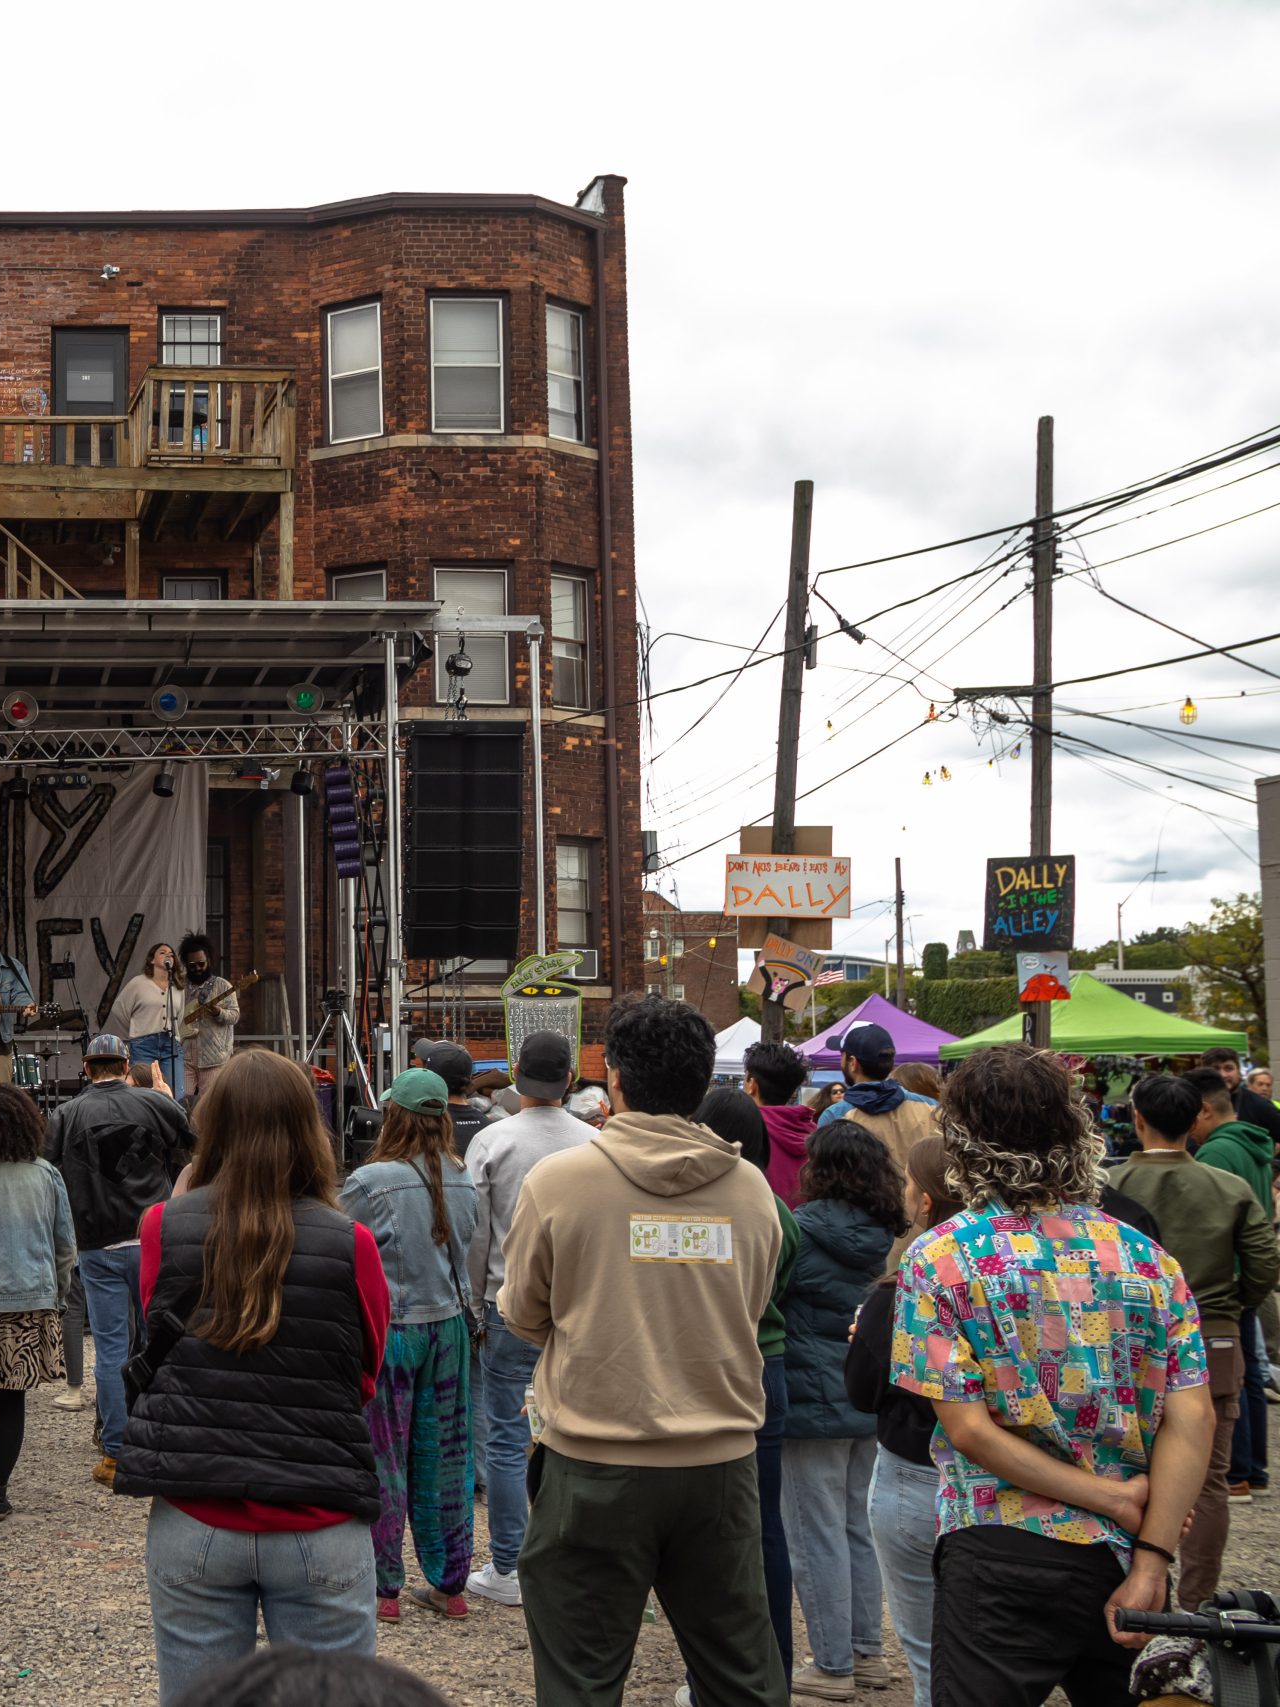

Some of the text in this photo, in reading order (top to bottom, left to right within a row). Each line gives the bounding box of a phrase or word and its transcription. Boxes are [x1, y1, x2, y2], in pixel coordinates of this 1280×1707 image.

[994, 863, 1067, 896] DALLY
[731, 882, 849, 914] DALLY
[993, 909, 1059, 936] ALLEY
